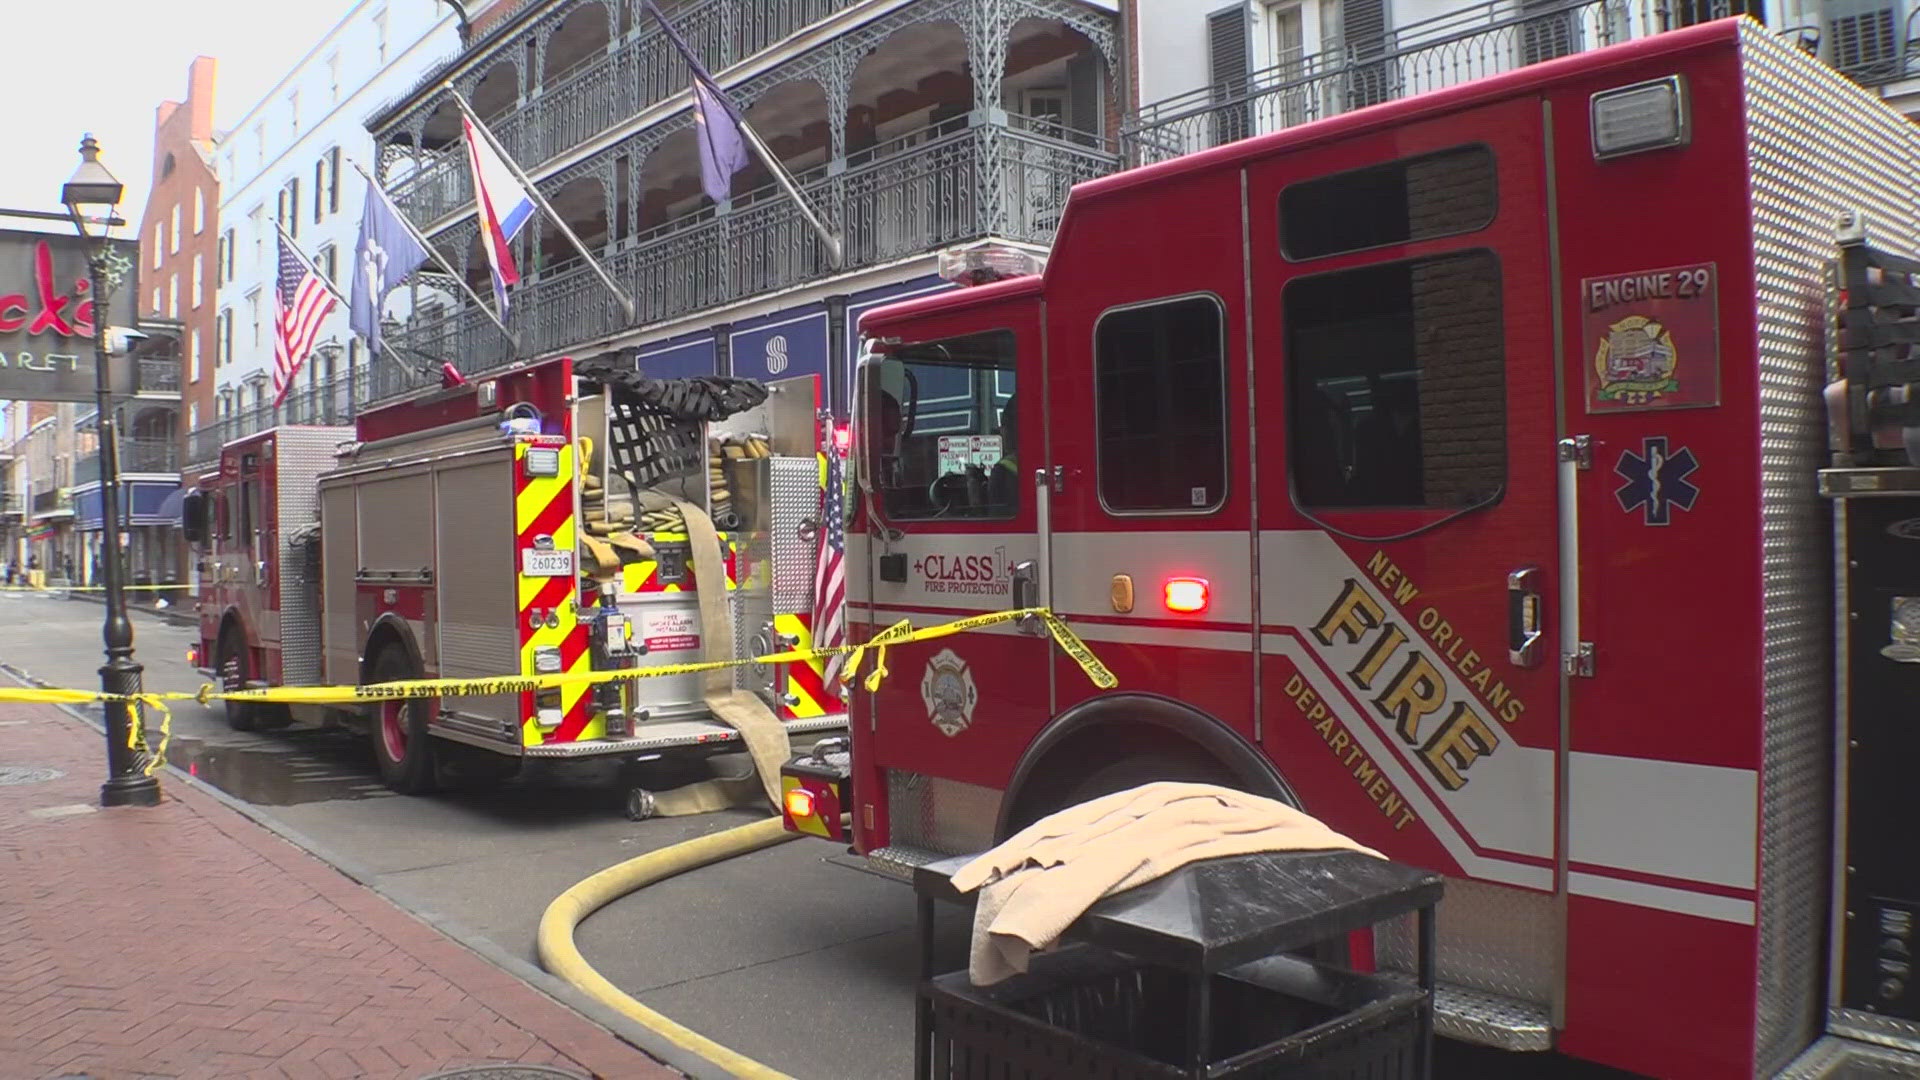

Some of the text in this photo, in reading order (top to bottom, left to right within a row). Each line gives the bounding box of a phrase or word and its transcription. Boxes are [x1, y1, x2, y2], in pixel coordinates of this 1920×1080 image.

[1591, 268, 1710, 310] ENGINE 29
[532, 557, 570, 570] 260239
[924, 555, 994, 581] CLASS
[925, 581, 1009, 595] FIRE PROTECTION
[1366, 550, 1525, 723] NEW ORLEANS
[1309, 577, 1500, 791] FIRE
[1283, 673, 1416, 831] DEPARTMENT
